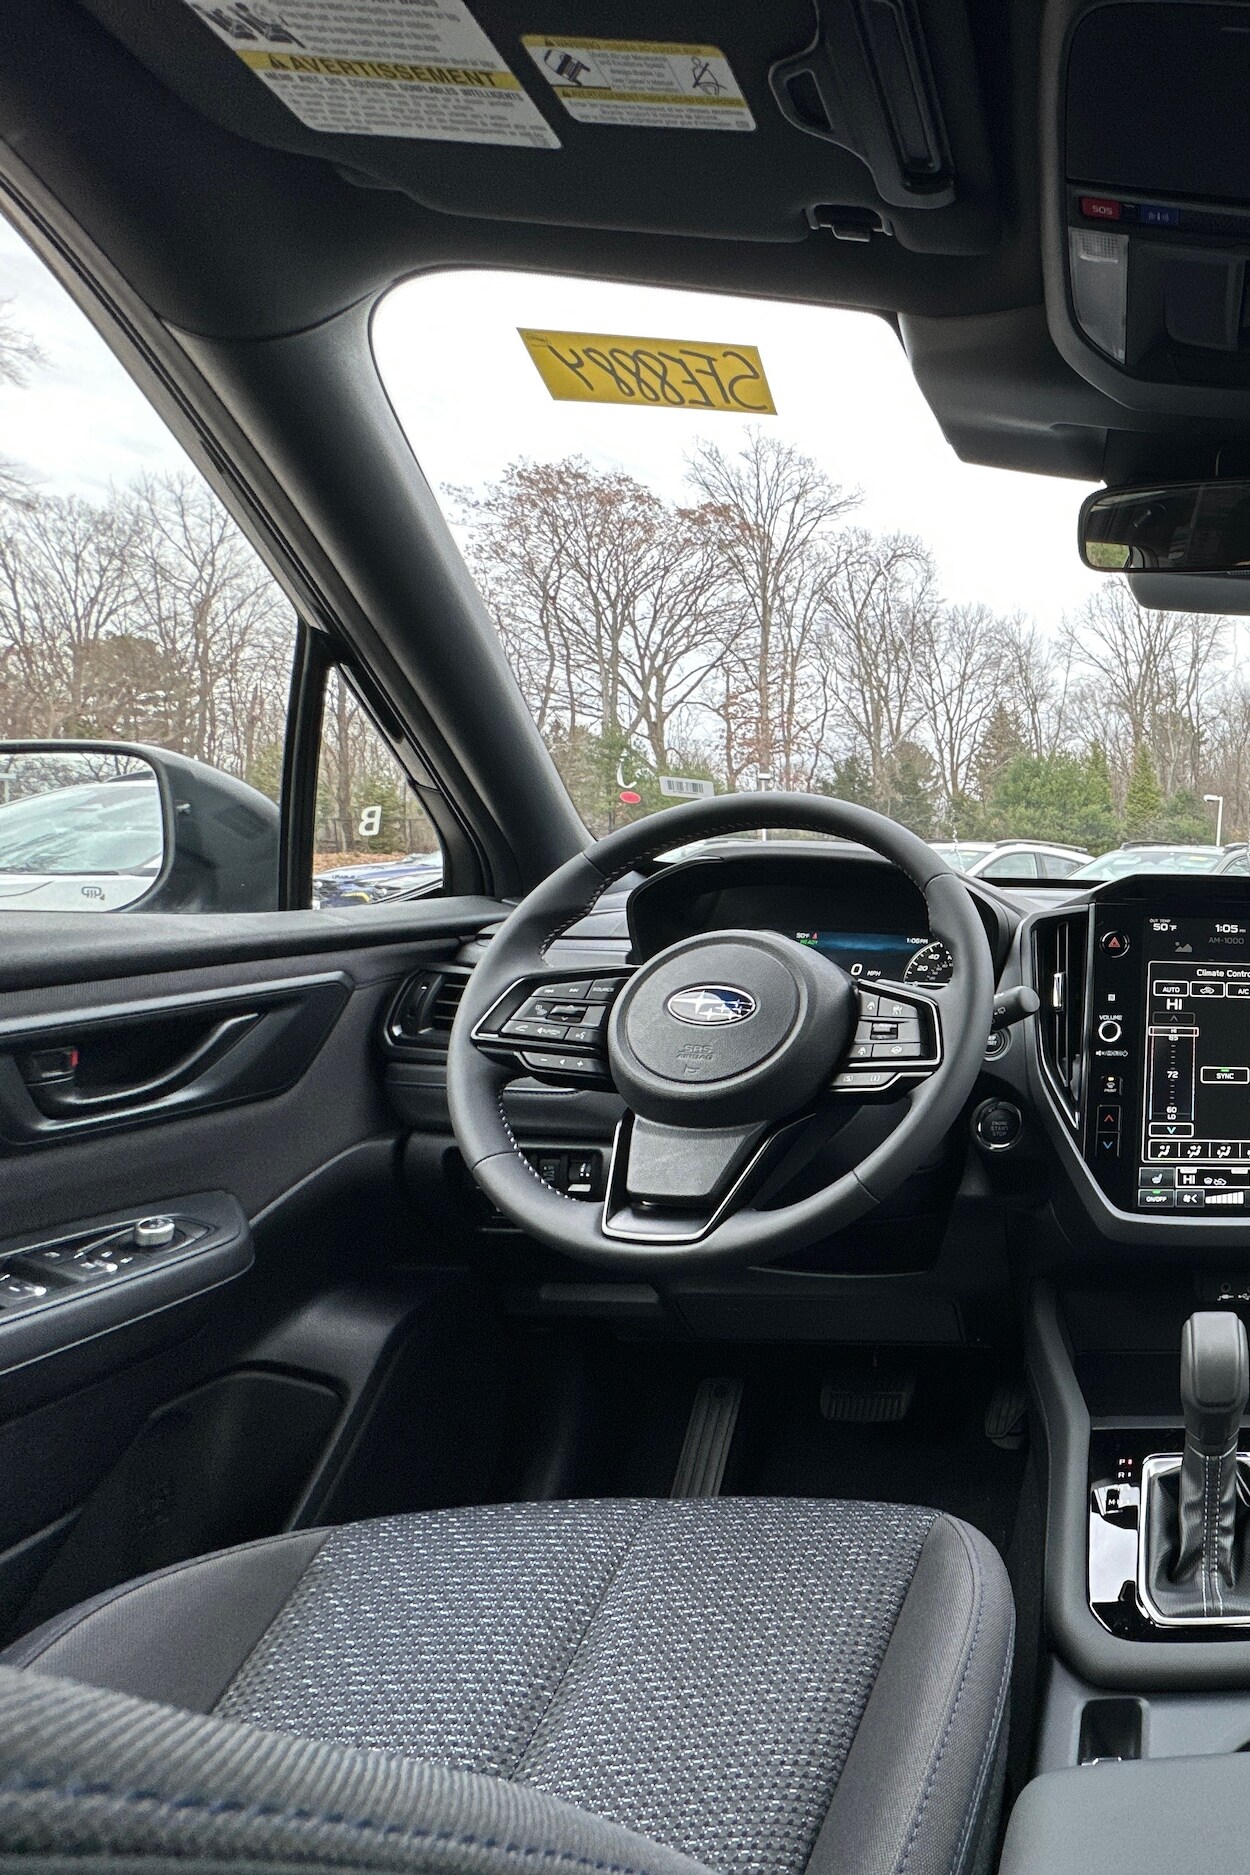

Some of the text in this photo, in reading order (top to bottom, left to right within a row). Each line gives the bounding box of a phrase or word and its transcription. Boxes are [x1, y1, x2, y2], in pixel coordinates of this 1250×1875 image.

[290, 54, 496, 87] AVERTISSEMENT
[1092, 205, 1112, 215] SOS
[1215, 924, 1239, 934] 1:05
[1208, 936, 1244, 945] AM-1000
[850, 963, 864, 976] 0
[1196, 968, 1225, 977] Climate
[1162, 986, 1180, 994] AUTO
[1166, 998, 1183, 1010] HI
[683, 1044, 714, 1054] SRS
[1167, 1071, 1178, 1079] 72
[1182, 1174, 1196, 1184] HI
[1119, 1458, 1126, 1466] P
[1118, 1471, 1125, 1479] R
